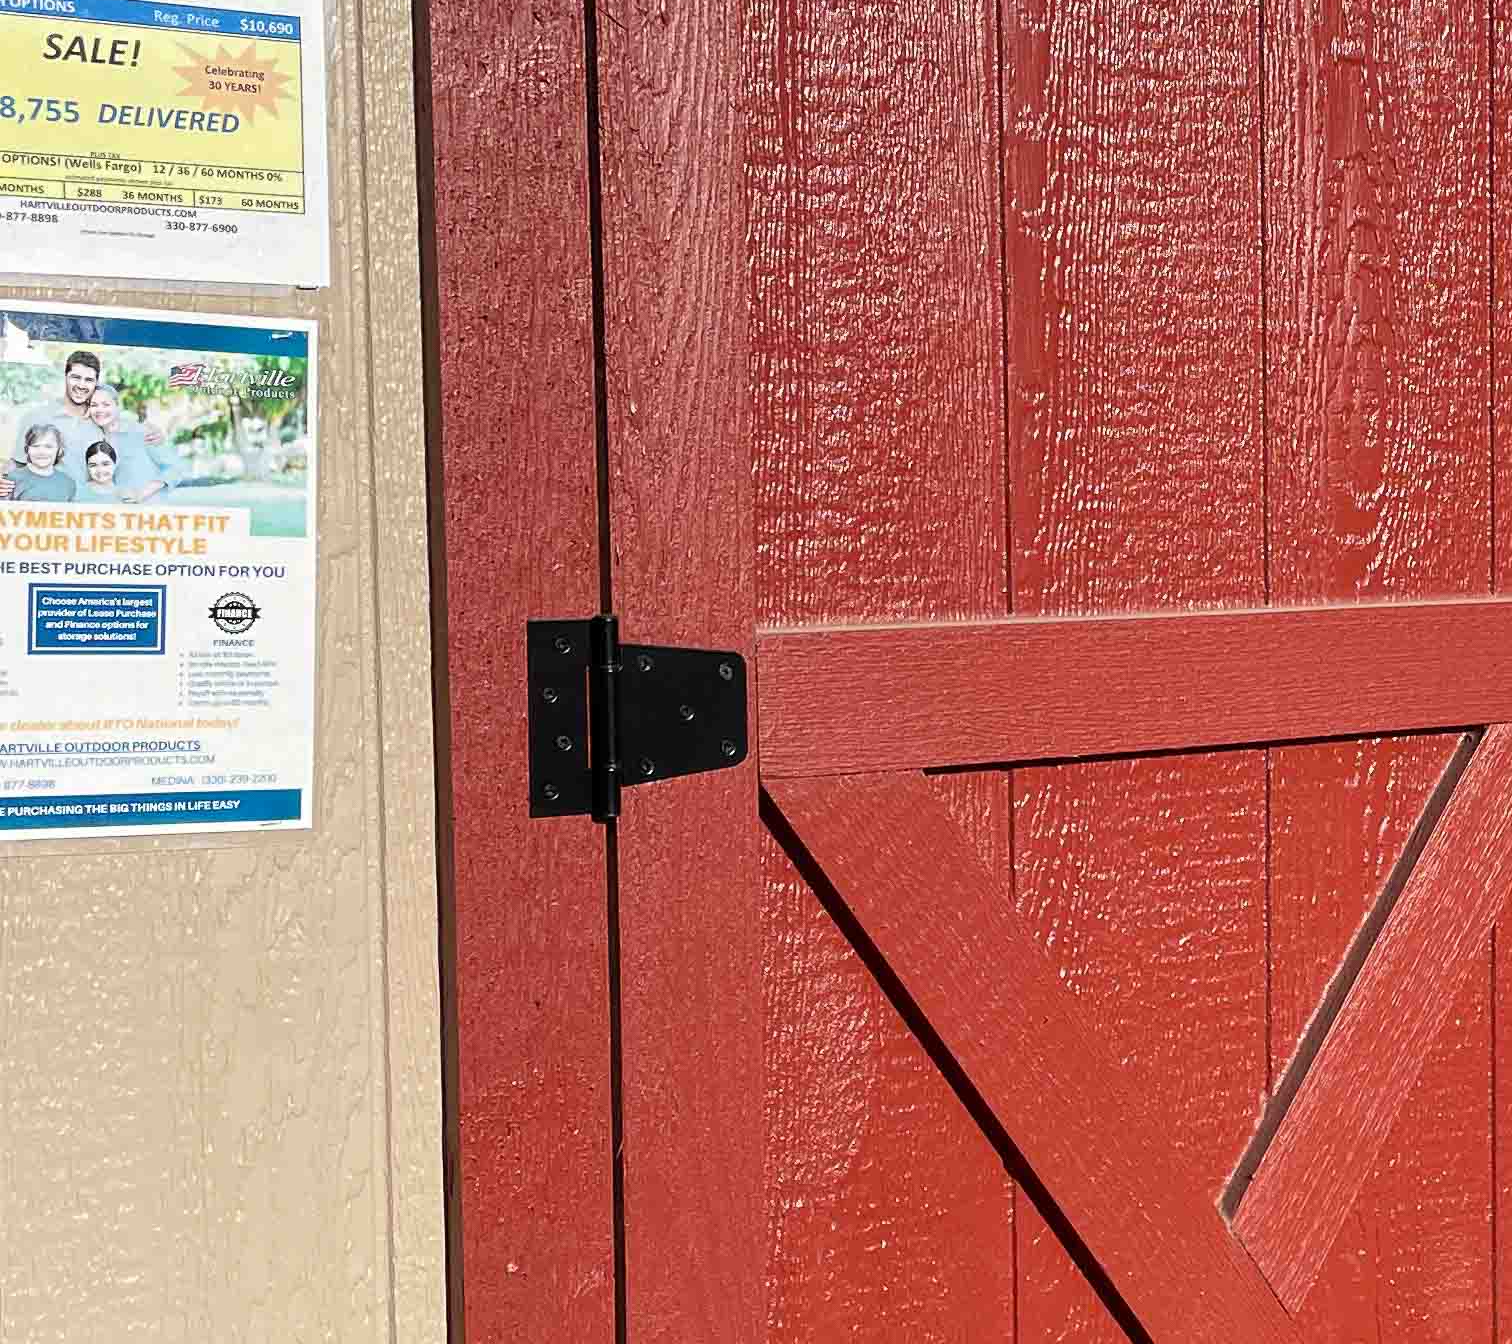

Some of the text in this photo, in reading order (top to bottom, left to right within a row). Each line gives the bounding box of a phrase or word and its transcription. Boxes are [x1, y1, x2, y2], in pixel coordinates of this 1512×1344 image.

[154, 9, 294, 35] Reg. Price $10,690
[42, 33, 141, 67] SALE!
[205, 65, 265, 81] Celebrating
[208, 80, 262, 94] 30 YEARS!
[0, 96, 240, 133] 8,755 DELIVERED
[2, 153, 61, 167] OPTIONS!
[65, 158, 101, 170] (Wells
[105, 160, 142, 174] Fargo)
[153, 164, 166, 174] 12
[201, 167, 214, 177] 60
[216, 169, 265, 181] MONTHS
[266, 172, 283, 182] 0%
[122, 190, 134, 200] 36
[138, 192, 183, 203] MONTHS
[199, 195, 223, 206] $173
[241, 198, 253, 207] 60
[256, 199, 299, 210] MONTHS
[0, 211, 58, 223] -877-8898
[21, 200, 197, 219] HARTVILLEOUTDOORPRODUCTS.COM
[166, 221, 238, 234] 330-877-6900
[121, 512, 189, 531] THAT
[192, 514, 231, 533] FIT
[75, 535, 208, 555] LIFESTYLE
[19, 562, 62, 575] BEST
[64, 562, 152, 576] PURCHASE
[155, 564, 215, 577] OPTION
[219, 565, 250, 577] FOR
[252, 566, 285, 578] YOU
[41, 596, 77, 606] Choose
[78, 597, 121, 607] America's
[37, 608, 77, 618] provider
[116, 609, 157, 618] Purchase
[45, 620, 64, 629] and
[101, 620, 136, 631] options
[136, 620, 149, 629] for
[213, 639, 256, 647] FINANCE
[64, 741, 130, 753] OUTDOOR
[132, 740, 201, 752] PRODUCTS
[7, 805, 82, 817] PURCHASING
[83, 804, 108, 815] THE
[110, 803, 129, 813] BIG
[131, 802, 174, 812] THINGS
[174, 801, 186, 811] IN
[188, 800, 211, 811] LIFE
[212, 799, 241, 810] EASY
